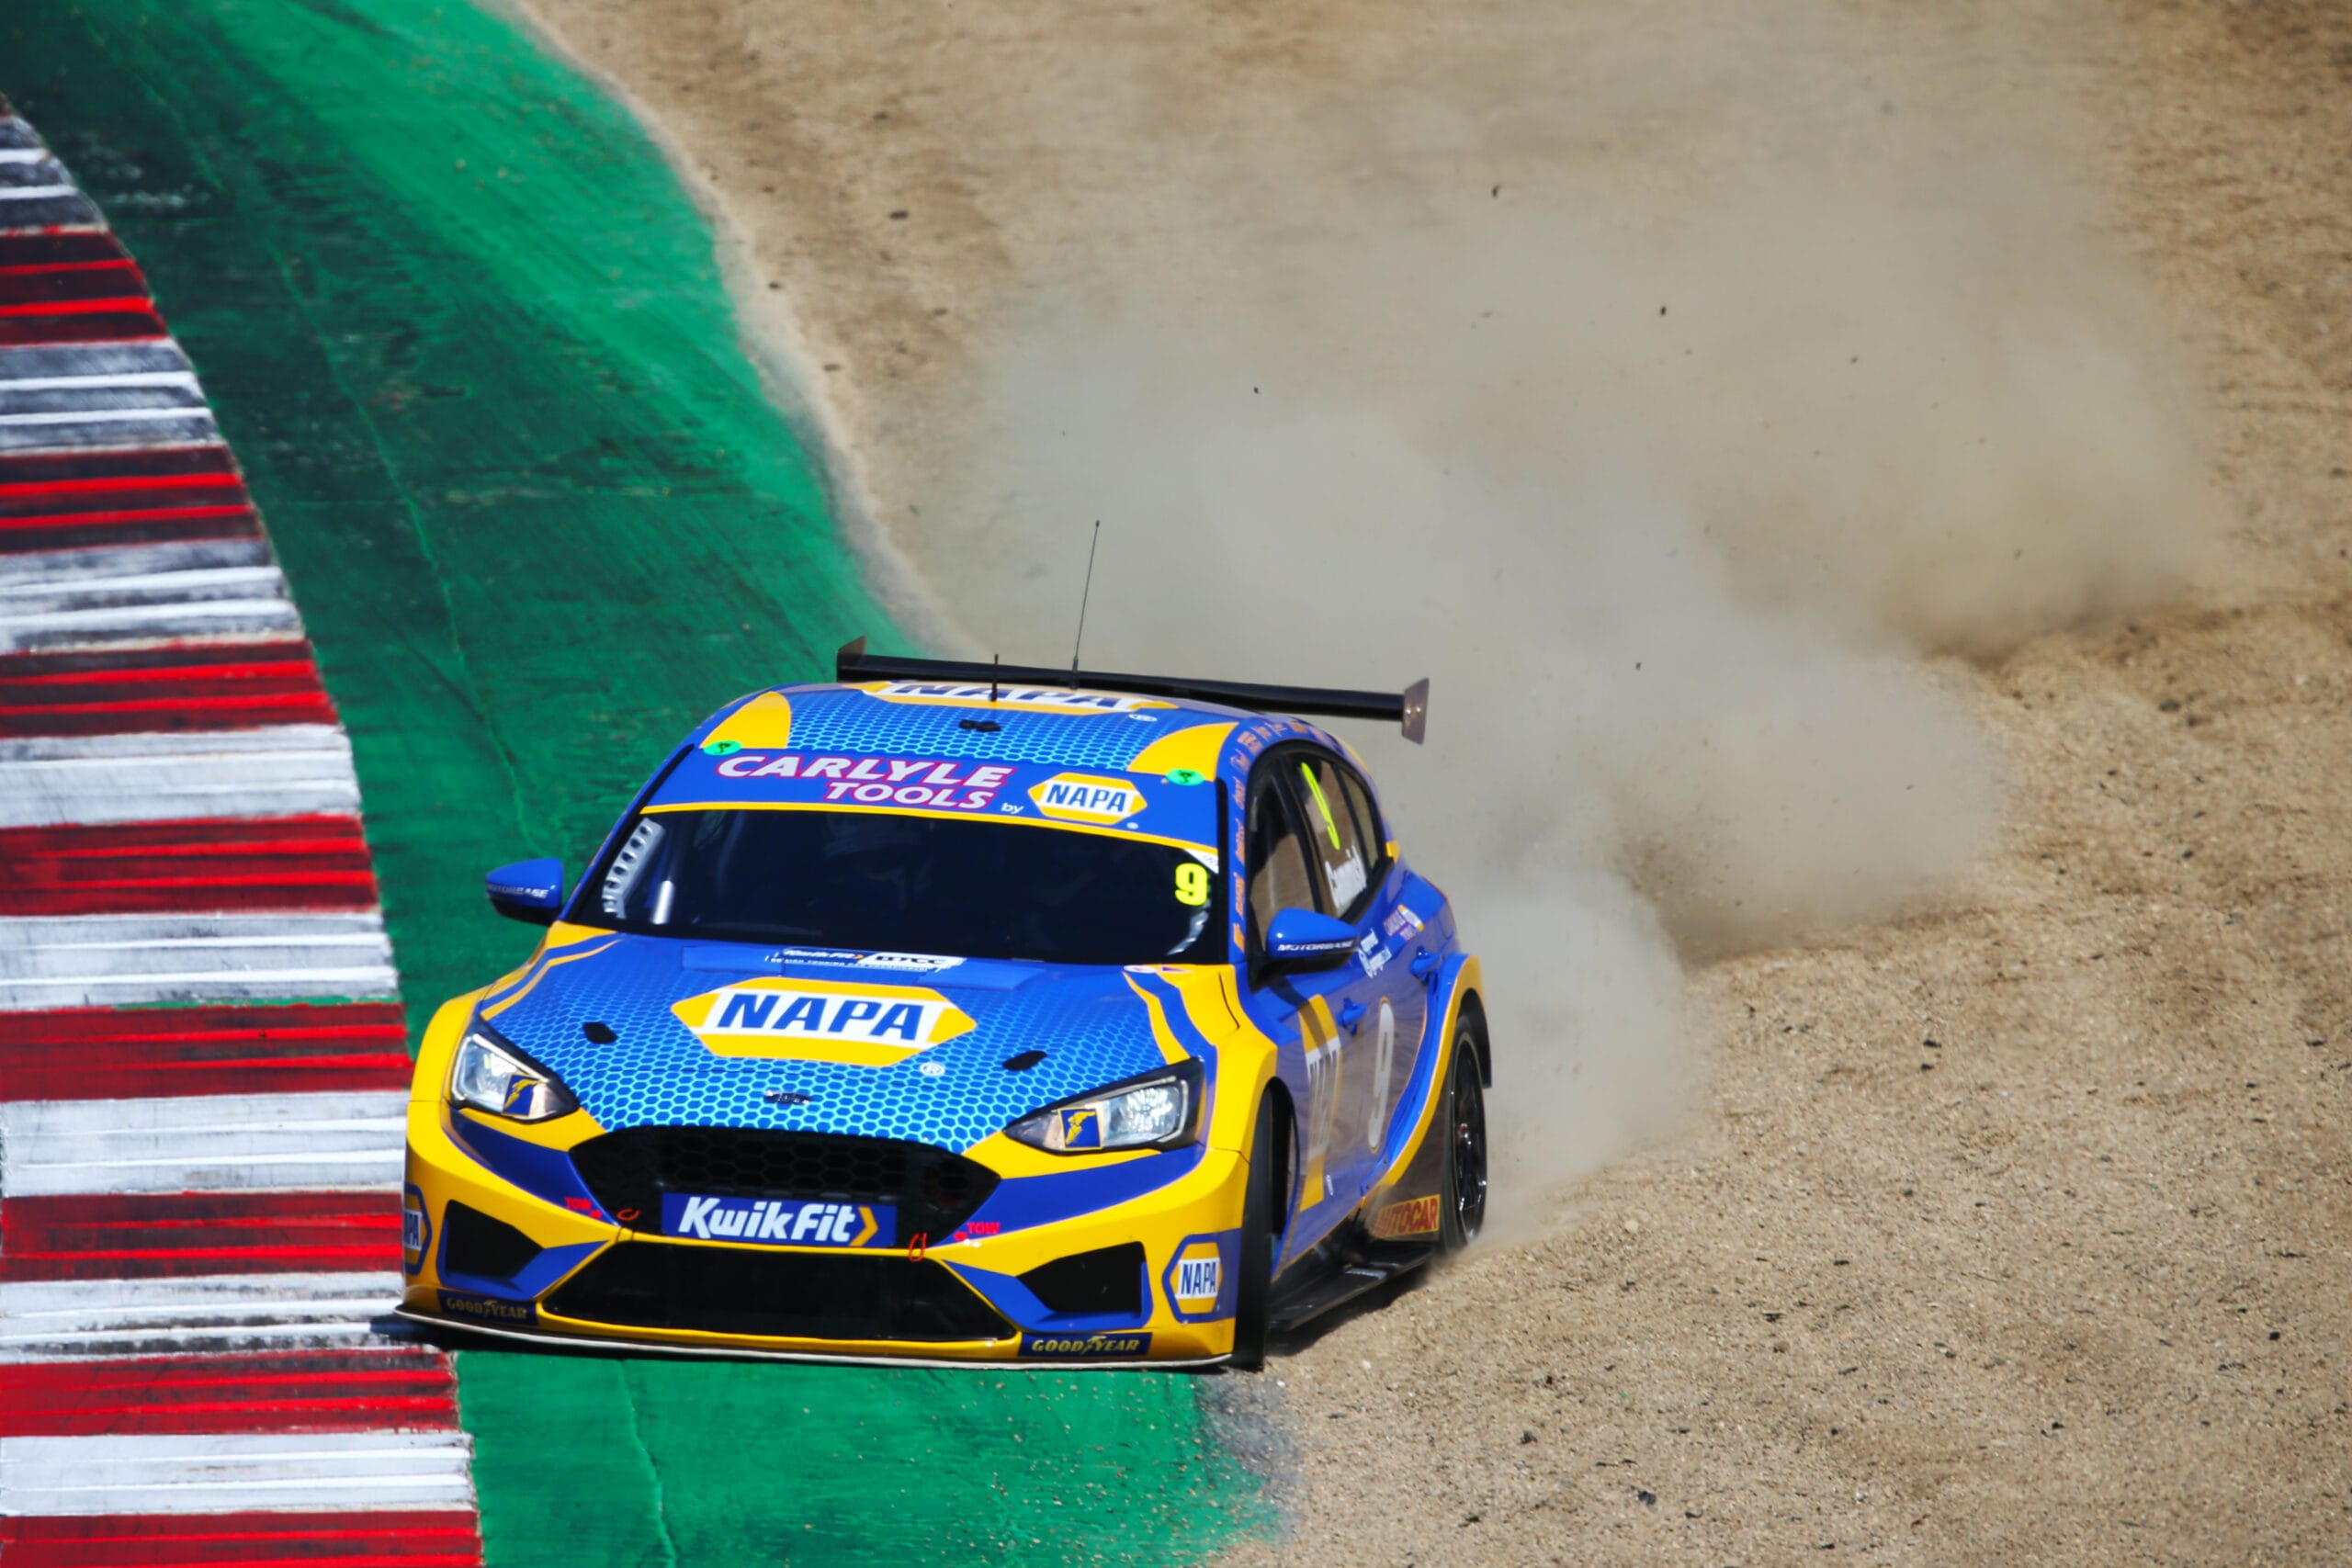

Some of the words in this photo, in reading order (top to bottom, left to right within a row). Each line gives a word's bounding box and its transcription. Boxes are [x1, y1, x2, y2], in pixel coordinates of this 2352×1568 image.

[894, 684, 1123, 708] NAPA
[717, 755, 1015, 788] CARLYLE
[825, 782, 996, 809] TOOLS
[1001, 802, 1024, 815] by
[1046, 784, 1126, 813] NAPA
[1175, 863, 1208, 907] 9
[717, 993, 924, 1041] NAPA
[1368, 1001, 1396, 1149] 9
[967, 1222, 1001, 1235] TOW
[1181, 1261, 1217, 1294] NAPA
